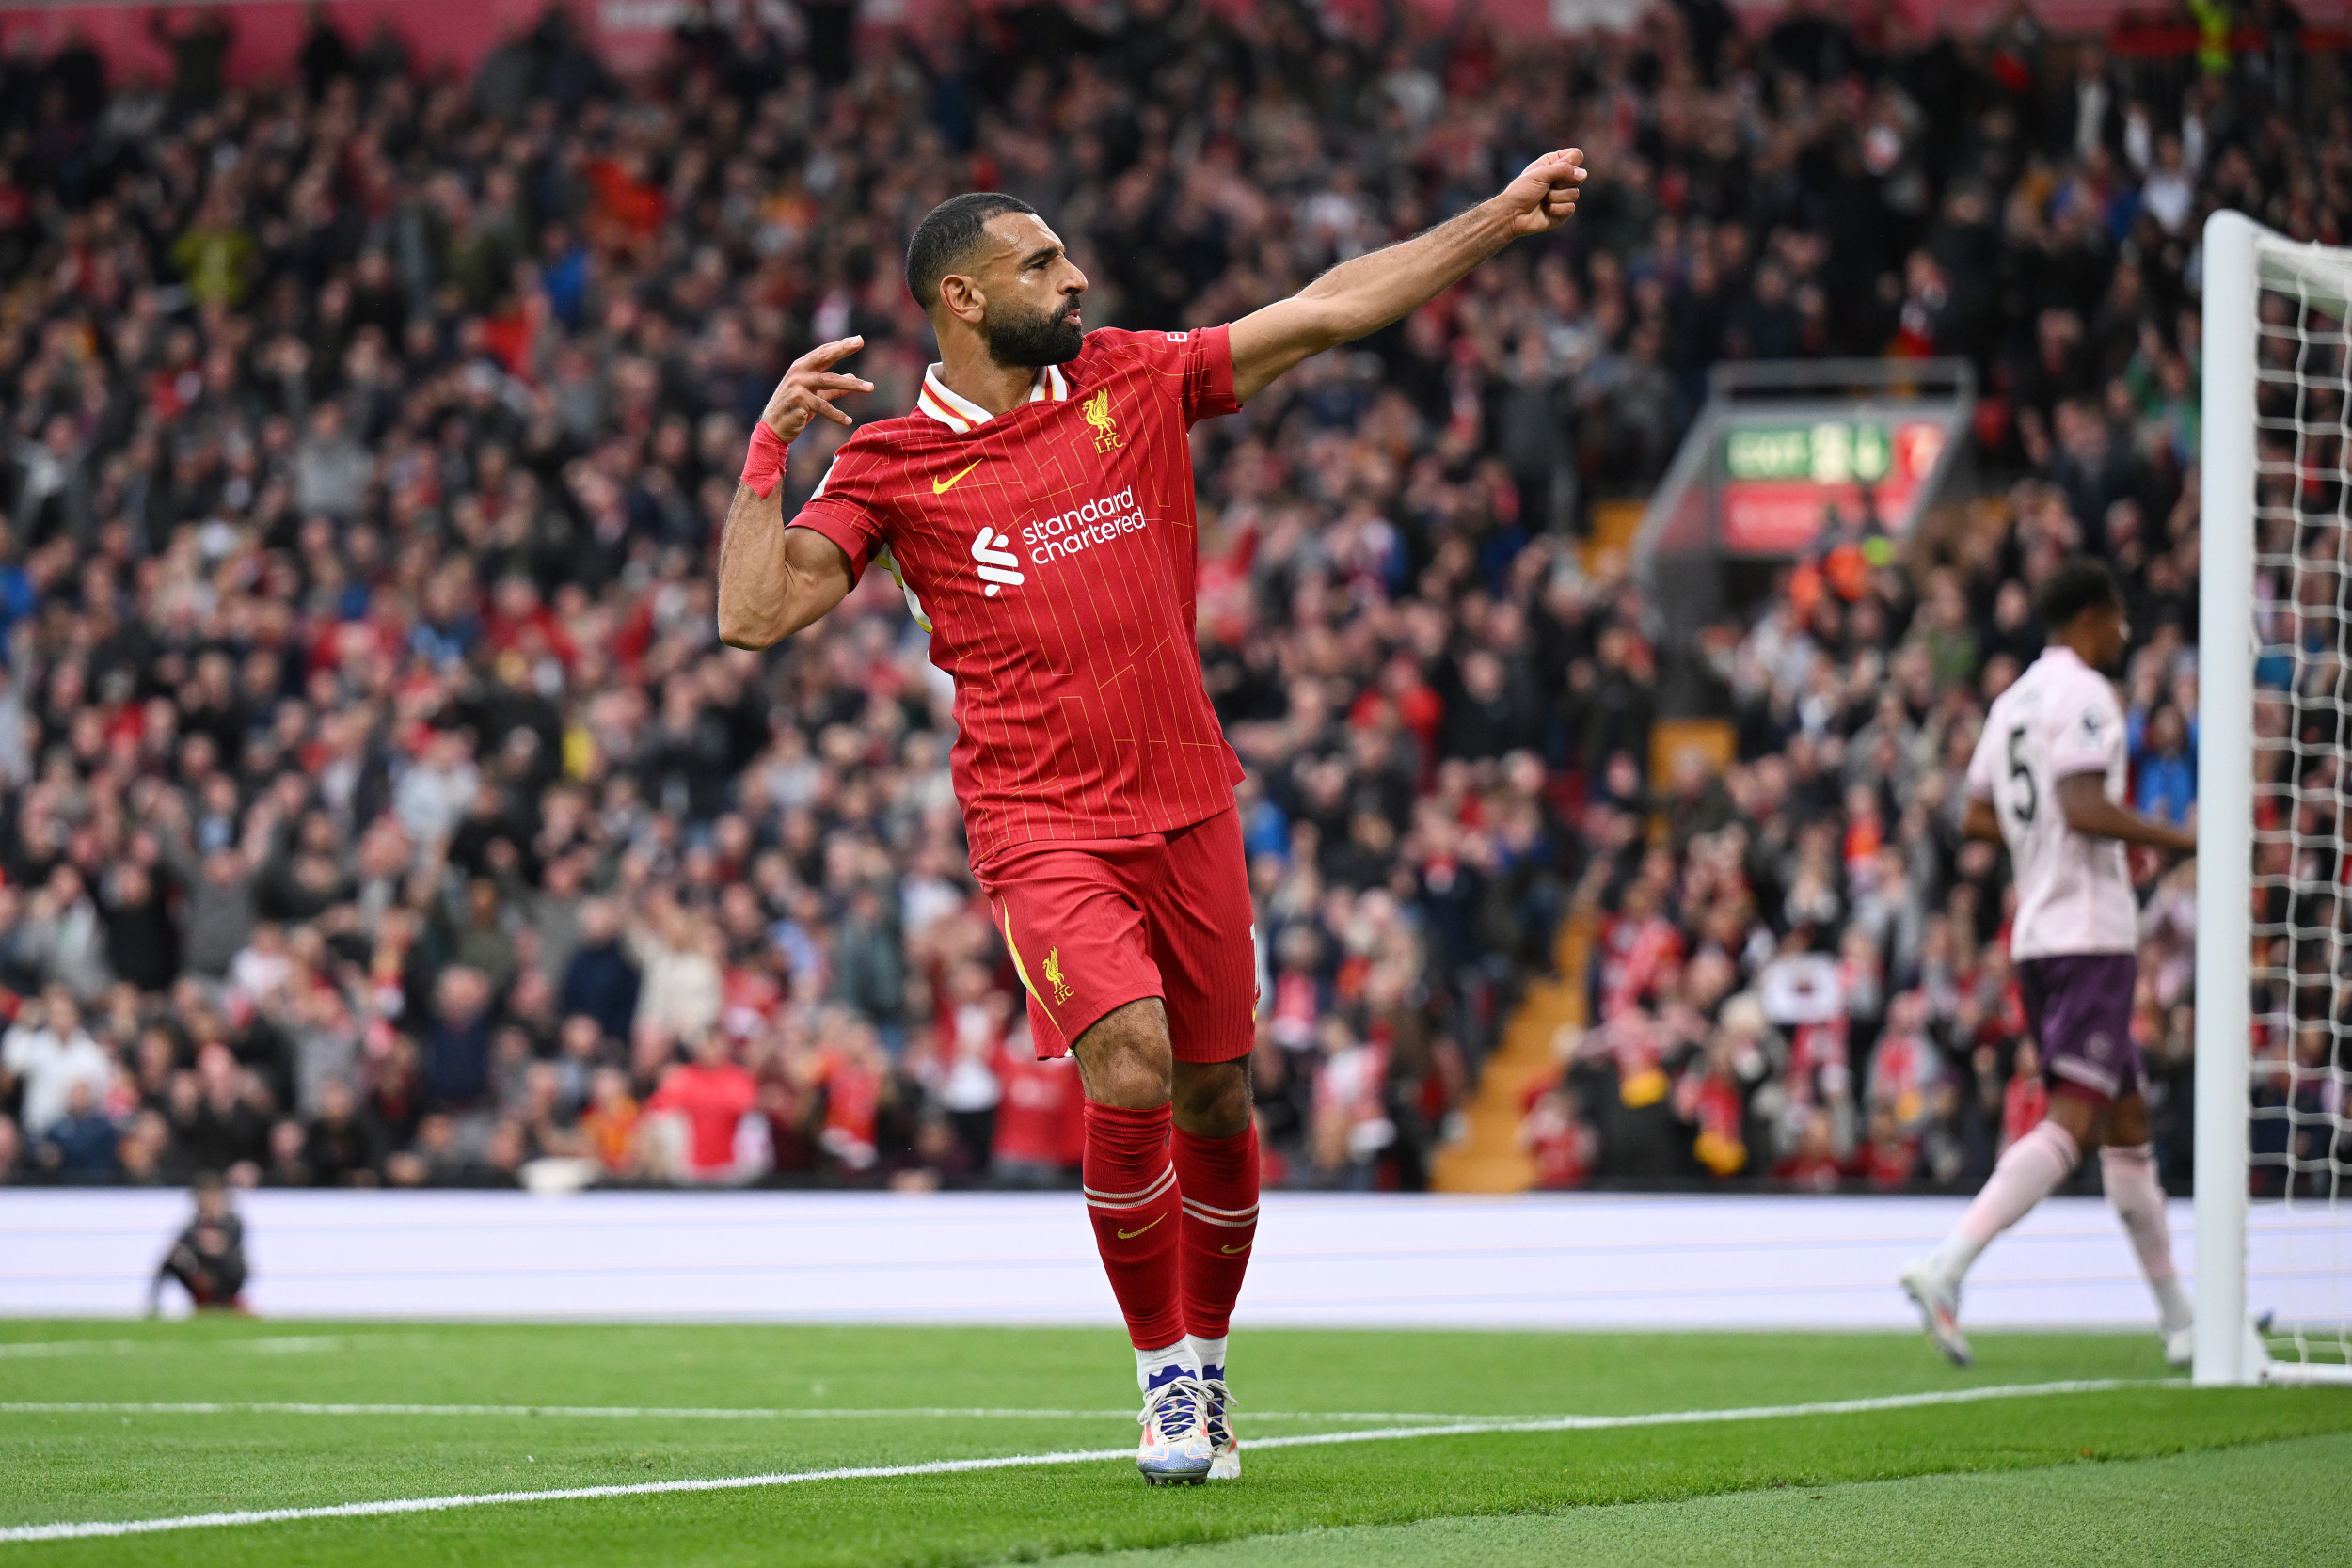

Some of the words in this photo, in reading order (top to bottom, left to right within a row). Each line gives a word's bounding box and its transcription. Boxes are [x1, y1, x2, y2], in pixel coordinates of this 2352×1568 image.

[1095, 435, 1126, 453] L.F.C.
[1022, 484, 1135, 546] standard
[1032, 506, 1146, 564] chartered
[2008, 726, 2037, 823] 5
